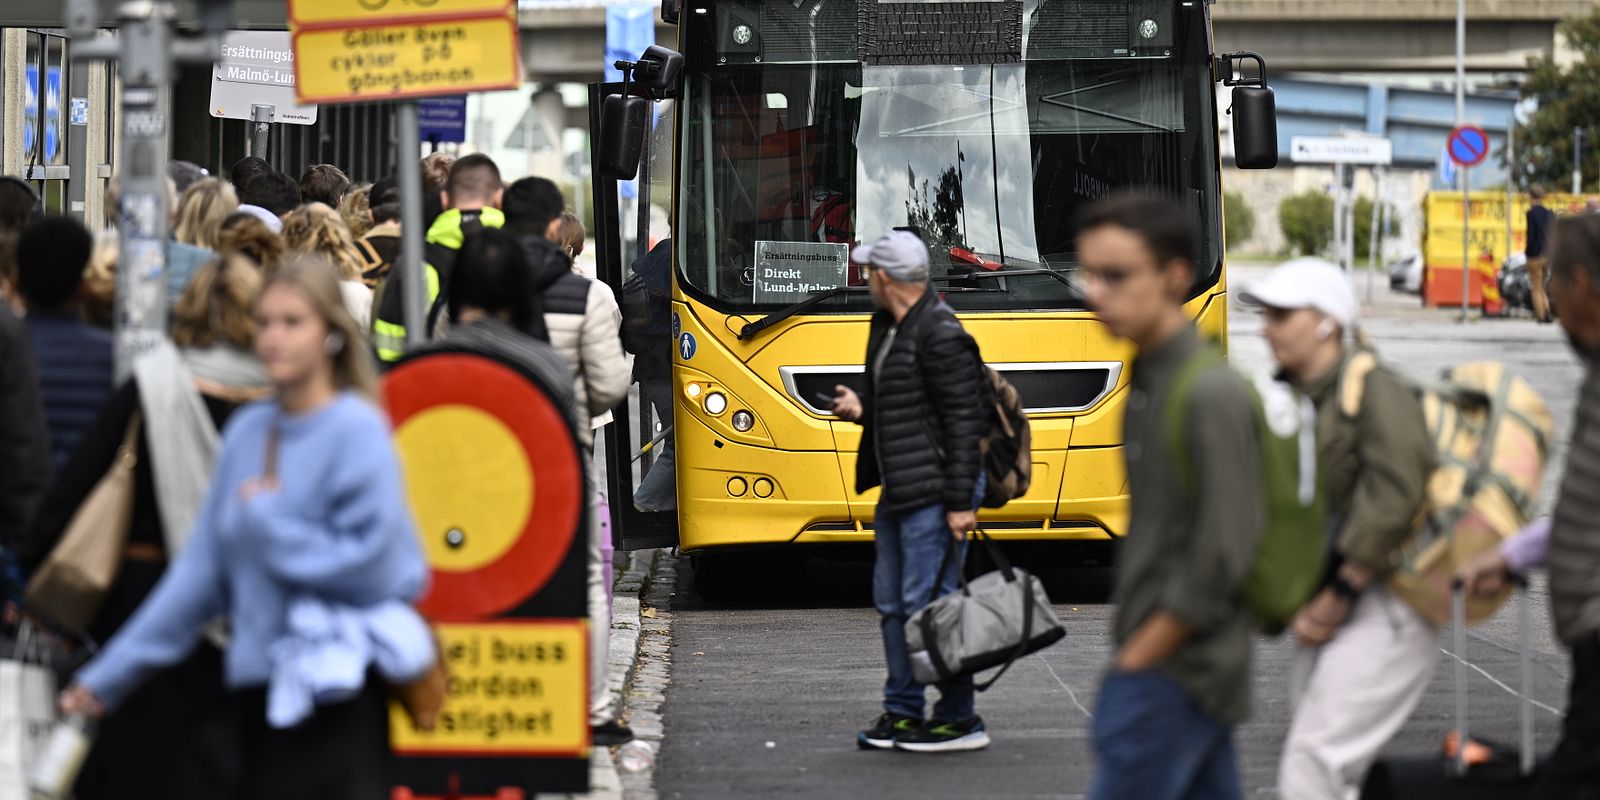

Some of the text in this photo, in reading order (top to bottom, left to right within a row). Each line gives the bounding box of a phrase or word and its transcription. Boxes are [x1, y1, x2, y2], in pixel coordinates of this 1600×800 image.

[343, 27, 466, 48] Gäller även
[221, 44, 294, 63] Ersättningsb
[330, 44, 451, 72] cyklar på
[228, 66, 295, 84] Malmö-Lun
[348, 68, 473, 92] gångbanan
[764, 251, 837, 262] Ersättningsbuss
[764, 268, 801, 279] Direkt
[491, 636, 567, 663] buss
[445, 672, 543, 699] ordon
